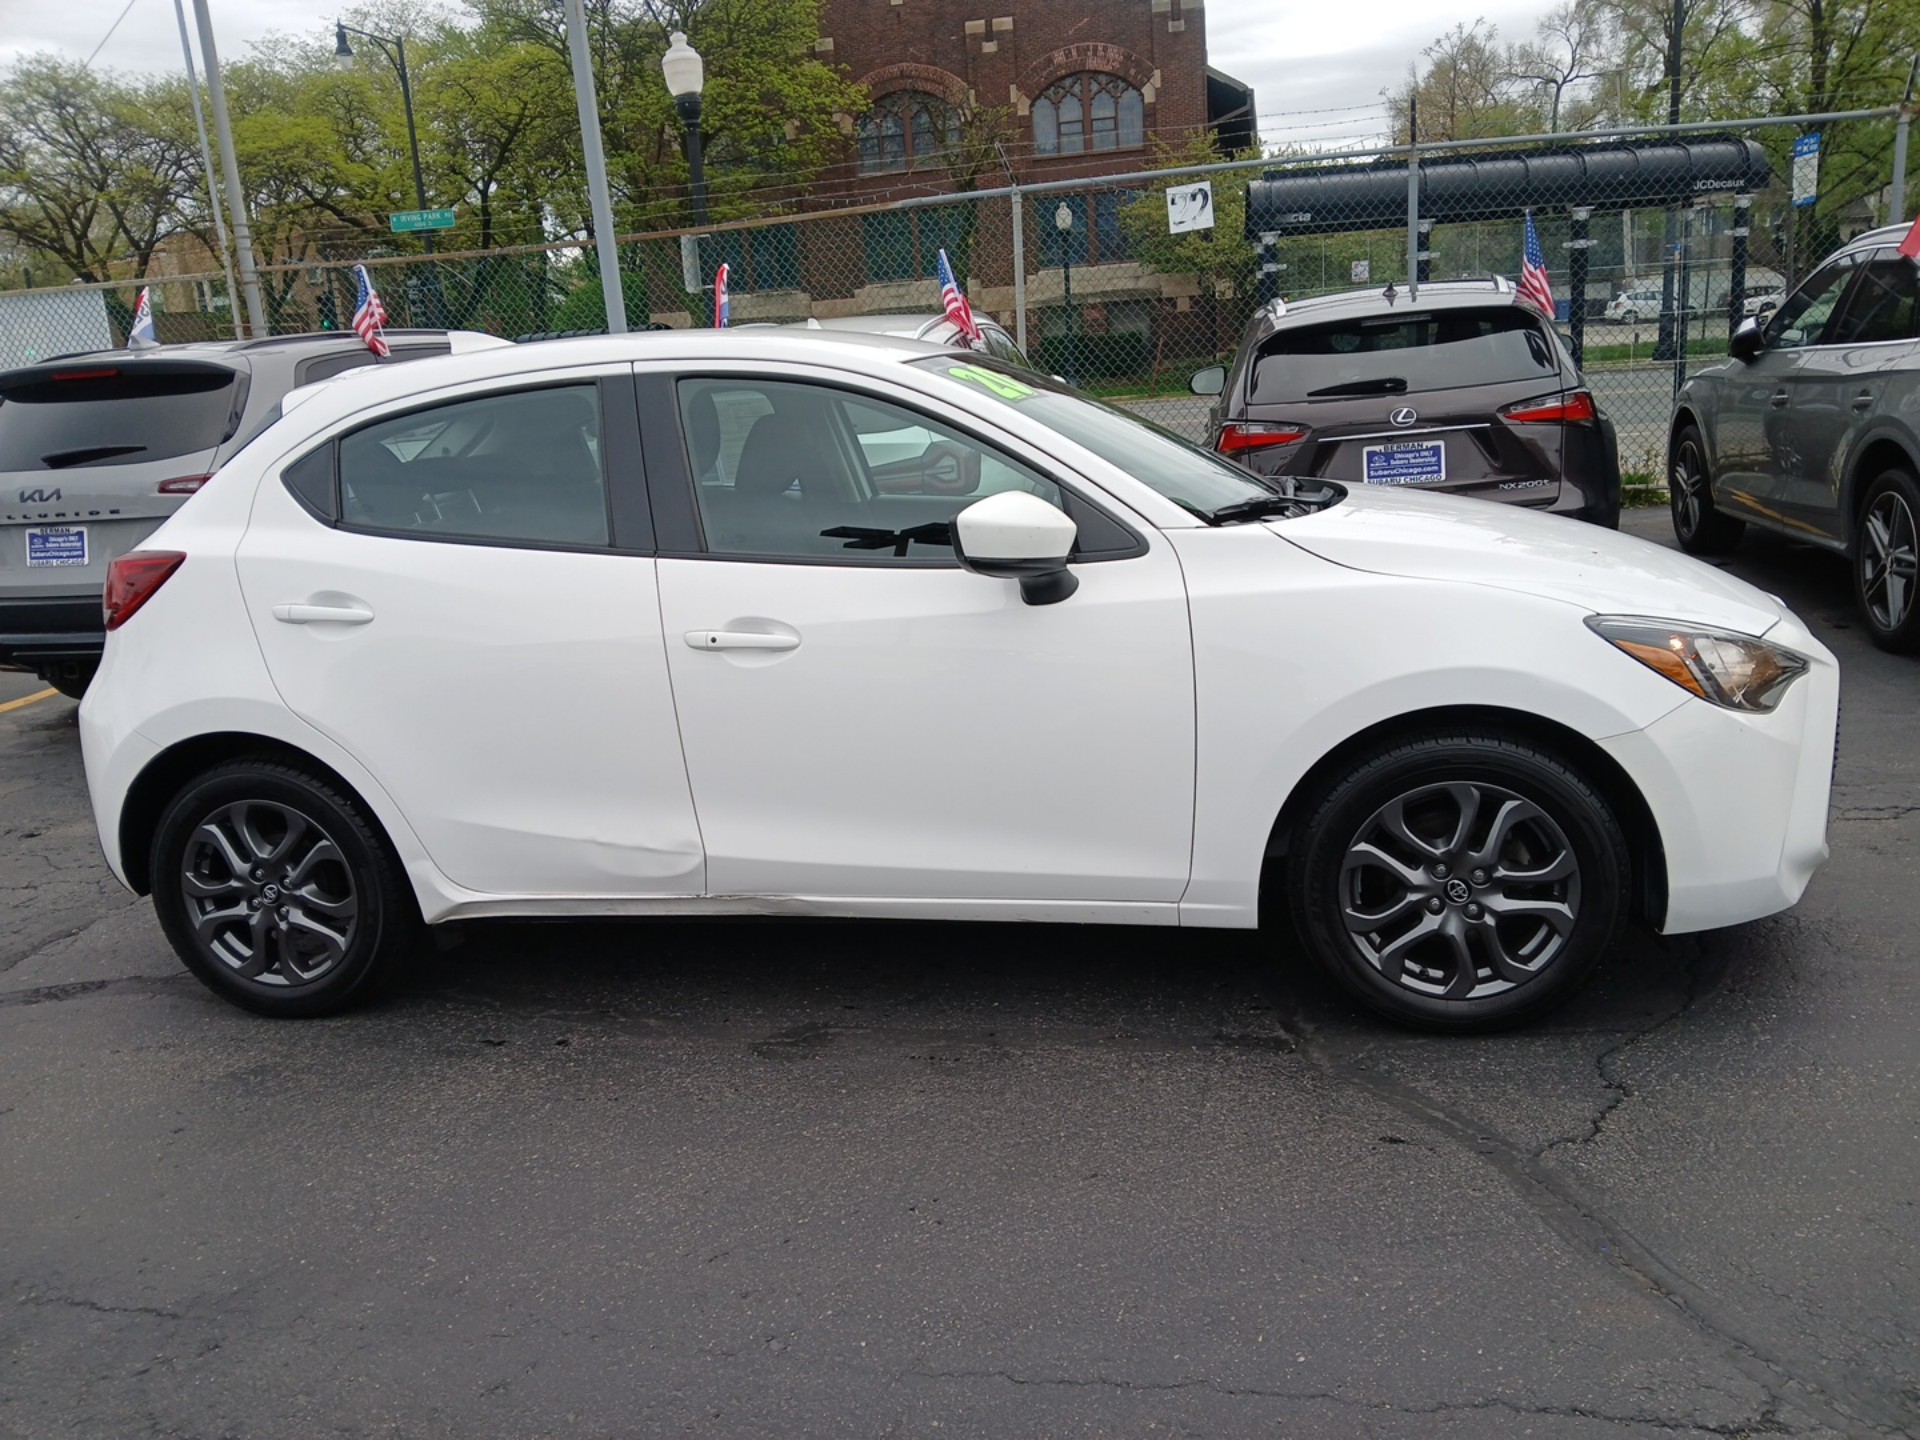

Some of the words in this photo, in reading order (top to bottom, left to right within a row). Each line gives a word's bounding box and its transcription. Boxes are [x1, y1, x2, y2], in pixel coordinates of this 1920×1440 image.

[1692, 179, 1745, 190] JCDecaux
[422, 211, 441, 221] PARK
[1384, 443, 1423, 452] BERMAN
[1369, 466, 1439, 477] SubaruChicago.com
[1403, 475, 1442, 483] CHICAGO
[19, 487, 62, 503] KIA
